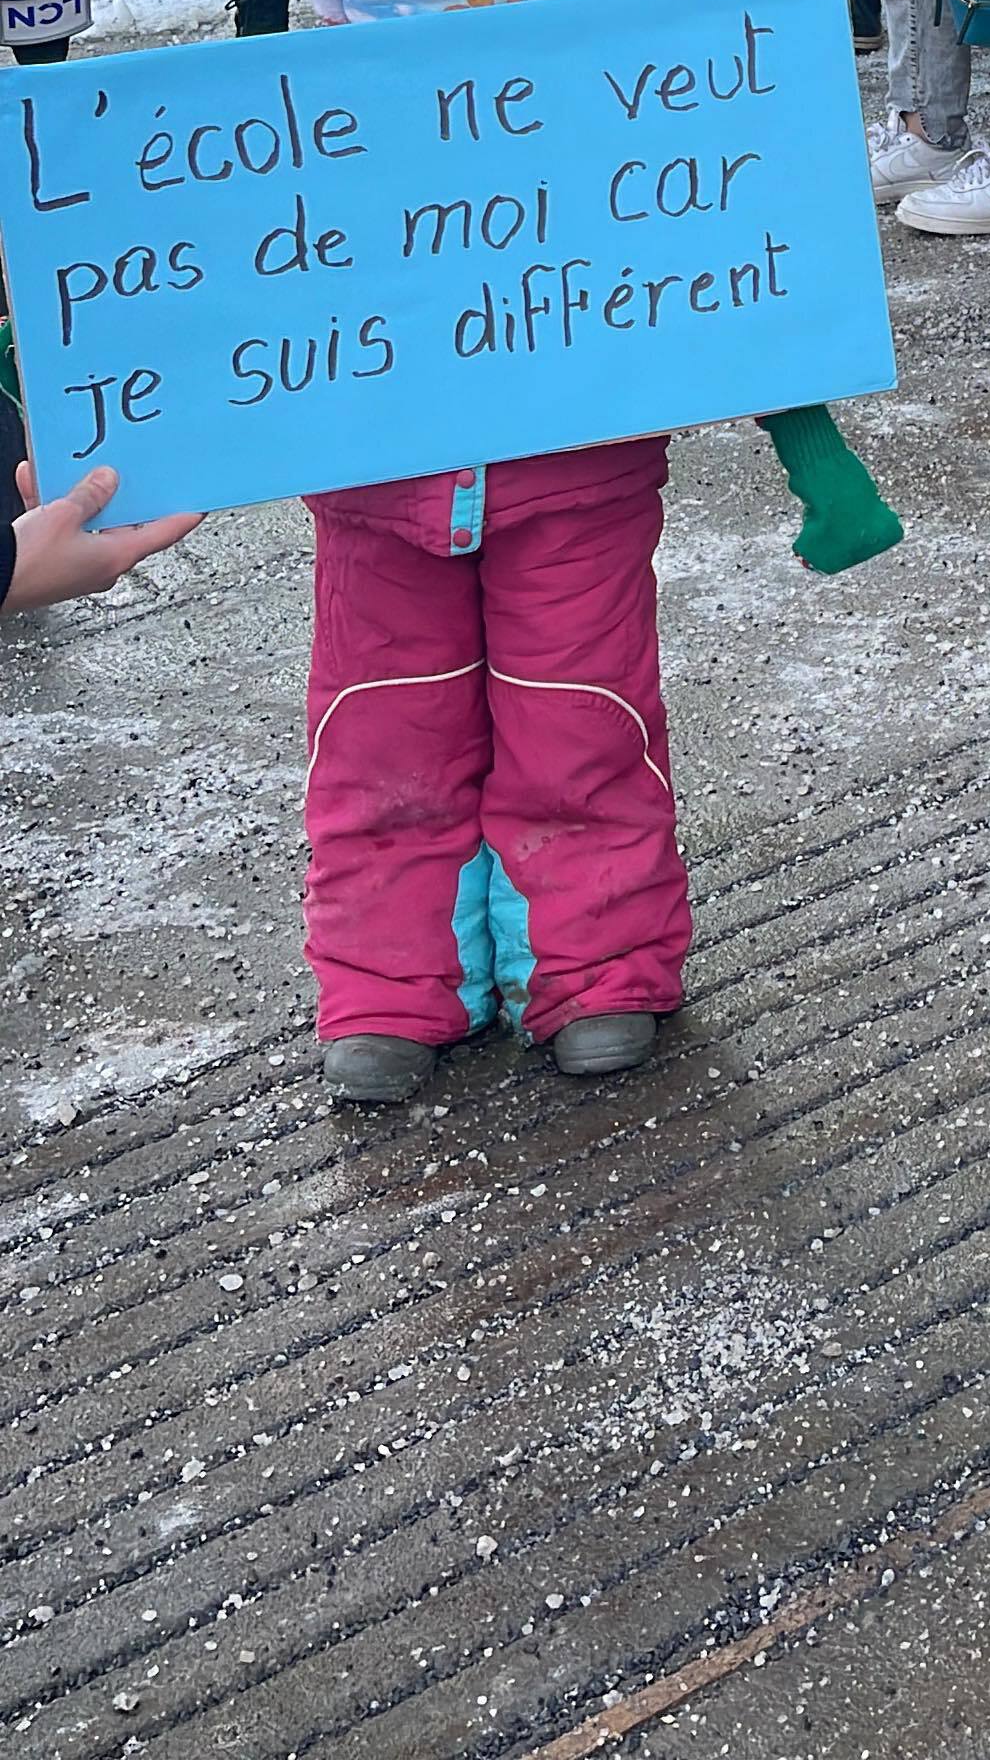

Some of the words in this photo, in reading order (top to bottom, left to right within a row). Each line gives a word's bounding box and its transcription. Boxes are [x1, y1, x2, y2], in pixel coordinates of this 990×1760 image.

[22, 72, 371, 215] L'école
[436, 75, 546, 144] ne
[602, 9, 779, 122] veut
[55, 237, 208, 349] pas
[254, 192, 357, 278] de
[401, 178, 552, 260] moi
[608, 149, 764, 223] car
[226, 314, 398, 408] suis
[453, 230, 793, 362] différent
